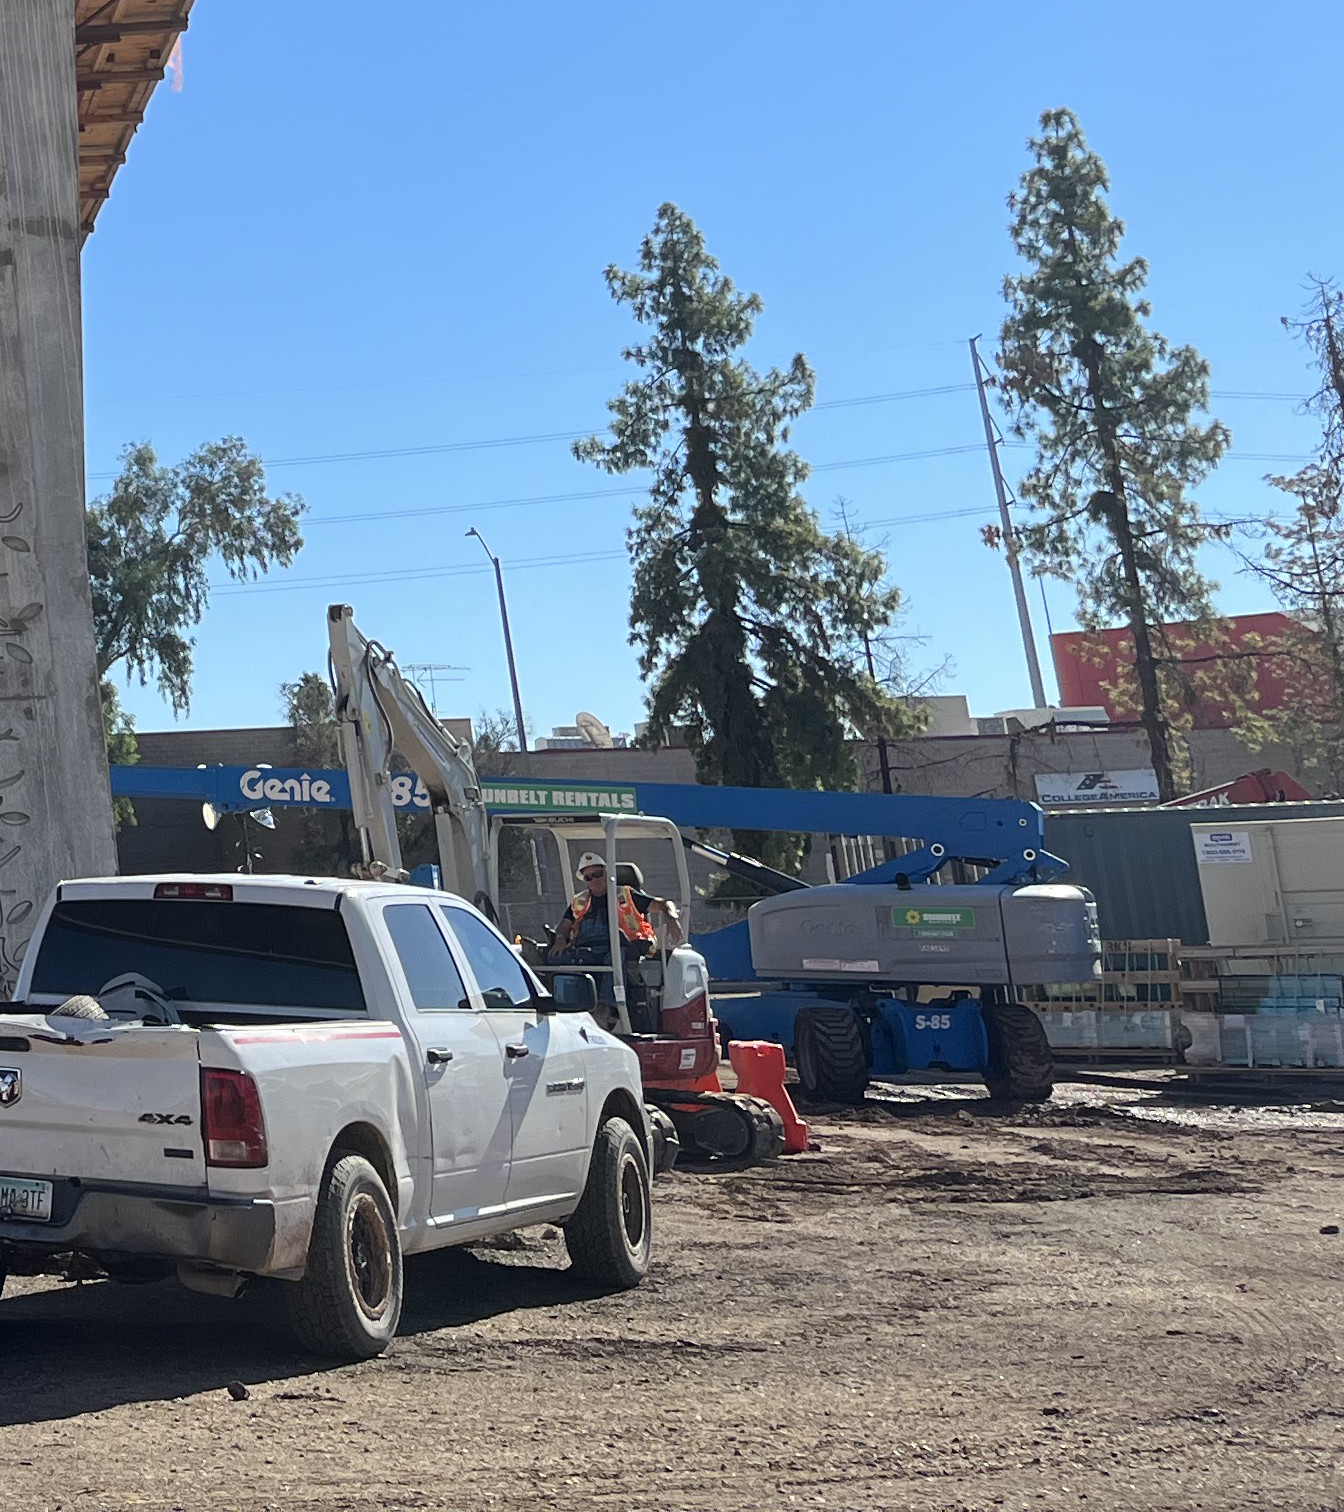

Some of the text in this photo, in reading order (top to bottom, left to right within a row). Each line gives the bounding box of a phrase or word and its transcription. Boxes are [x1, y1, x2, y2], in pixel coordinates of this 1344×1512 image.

[239, 768, 331, 803] Genie
[480, 788, 635, 809] UNBELT RENTALS
[915, 1014, 951, 1030] S-85
[138, 1113, 194, 1126] 4X4
